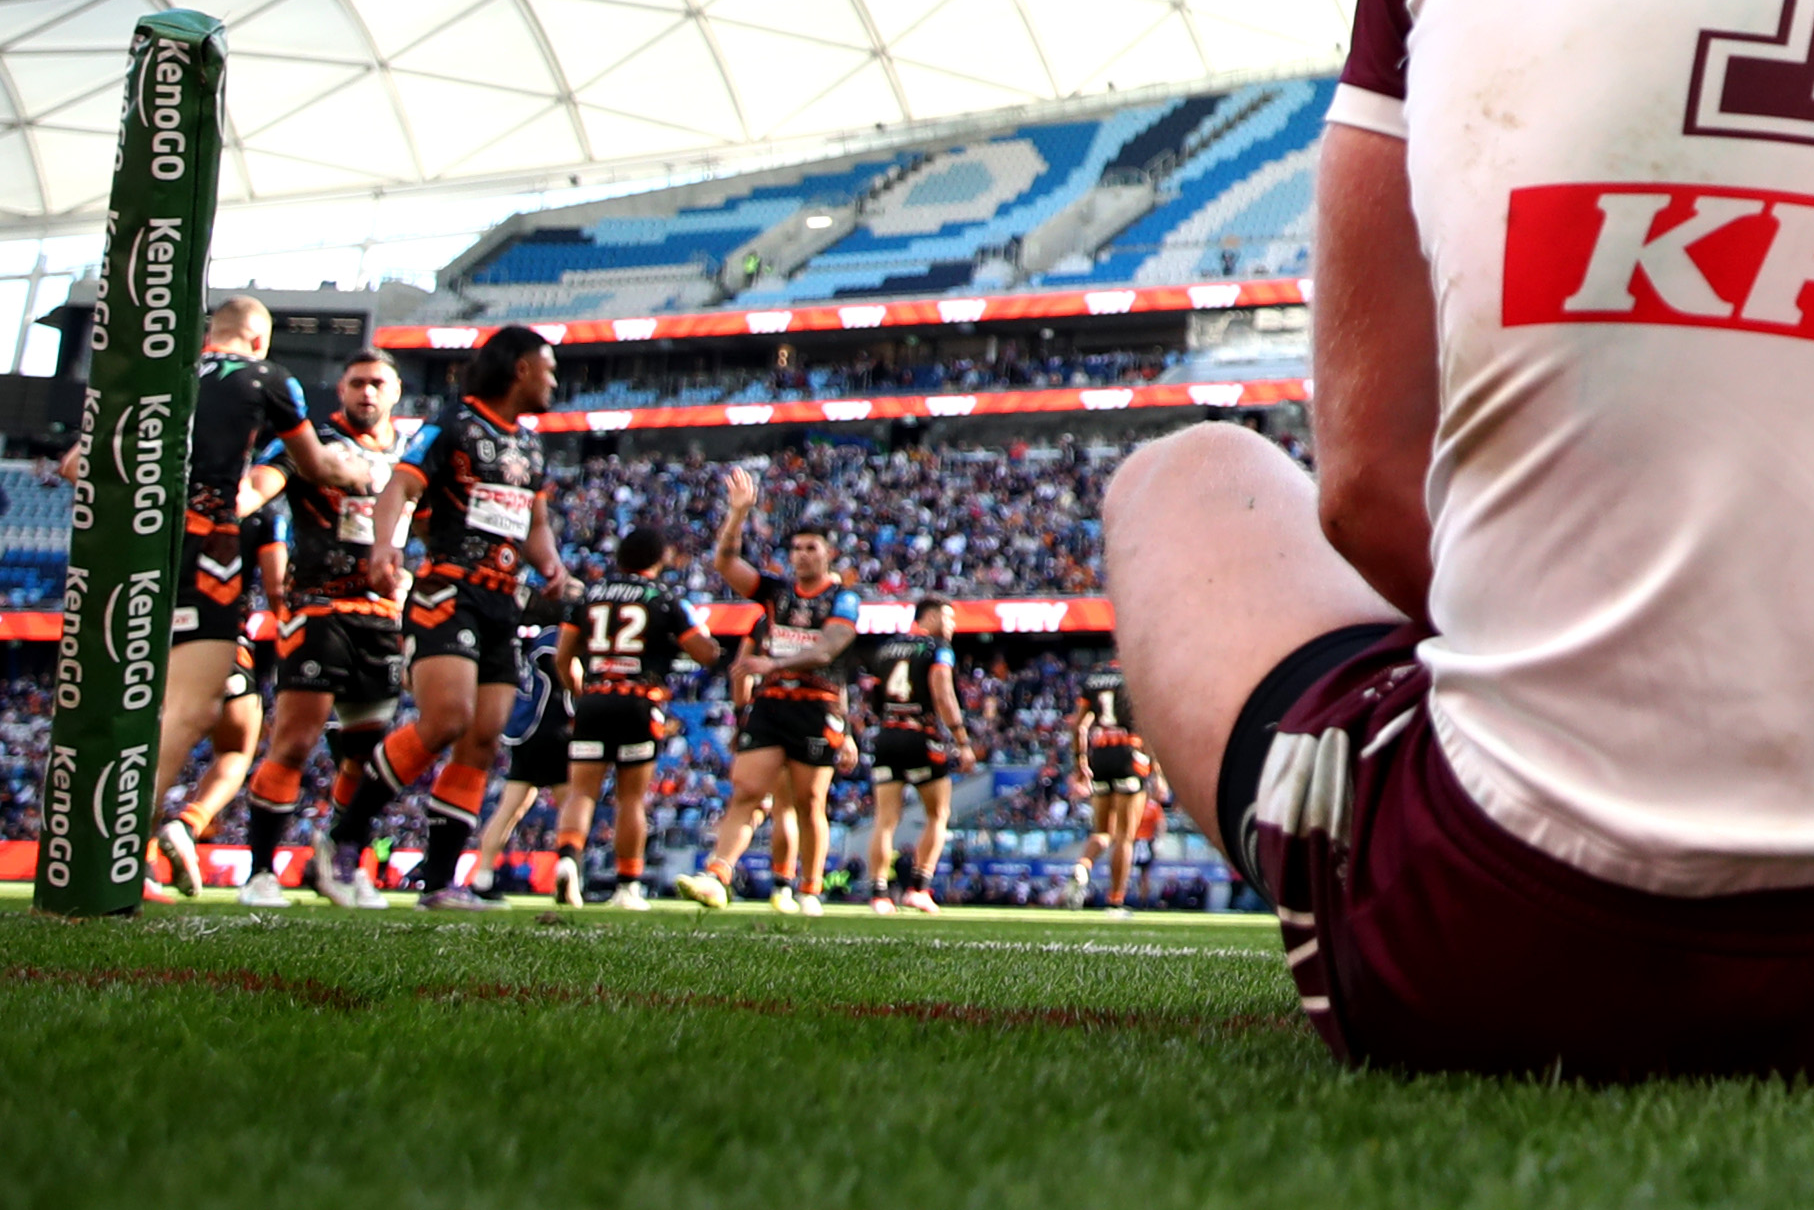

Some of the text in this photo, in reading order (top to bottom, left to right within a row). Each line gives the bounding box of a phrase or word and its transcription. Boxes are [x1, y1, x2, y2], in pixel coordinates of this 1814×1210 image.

[151, 37, 191, 181] KenoGO
[142, 218, 182, 359] KenoGO
[133, 394, 172, 536] KenoGO
[55, 565, 89, 710] KenoGO
[122, 570, 161, 711] KenoGO
[586, 604, 650, 654] 12
[886, 659, 913, 703] 4
[48, 744, 77, 888] KenoGO
[110, 743, 149, 885] KenoGO
